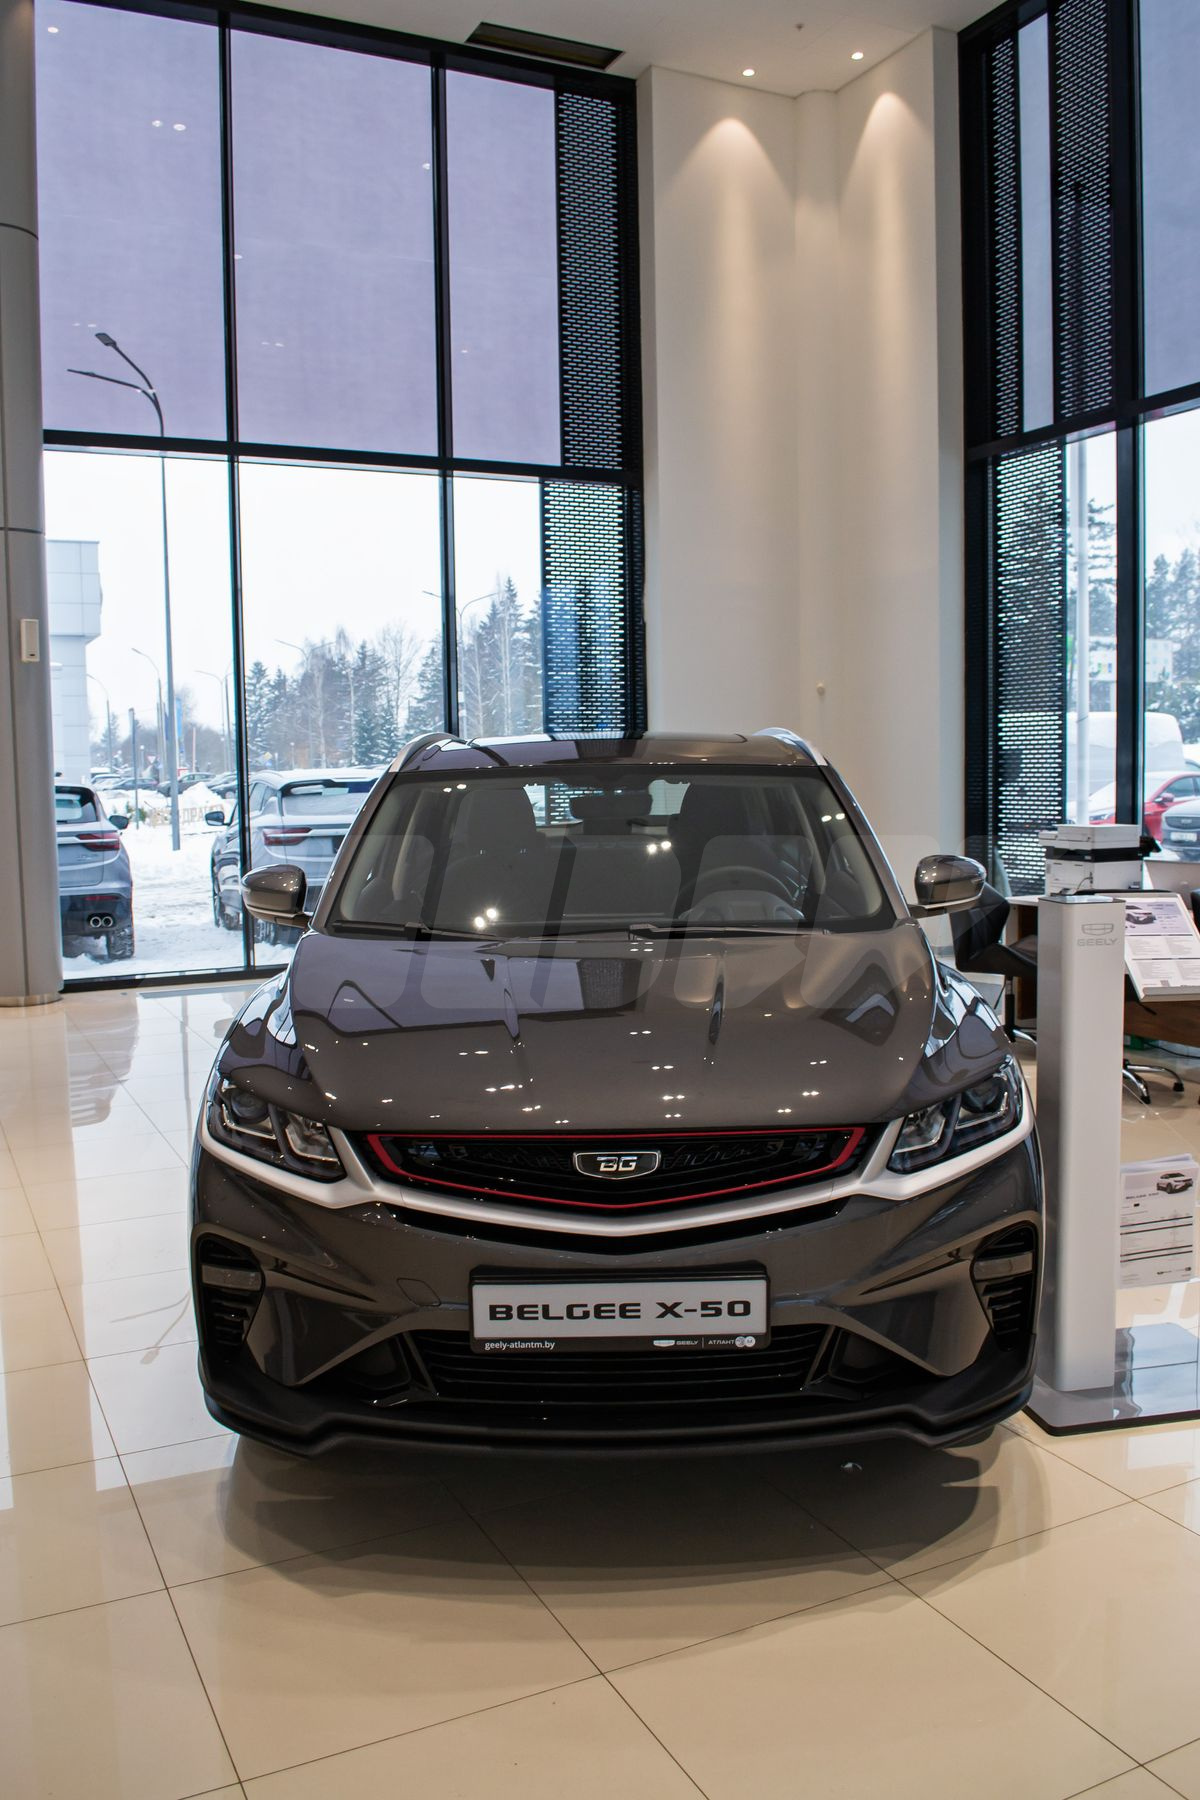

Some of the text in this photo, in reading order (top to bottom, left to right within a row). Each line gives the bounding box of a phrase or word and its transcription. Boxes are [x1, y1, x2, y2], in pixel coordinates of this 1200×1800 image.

[1077, 938, 1118, 947] GEELY
[597, 1156, 638, 1172] BG
[488, 1300, 751, 1321] BELGEE X-50
[484, 1340, 555, 1351] geely-atlantm.by
